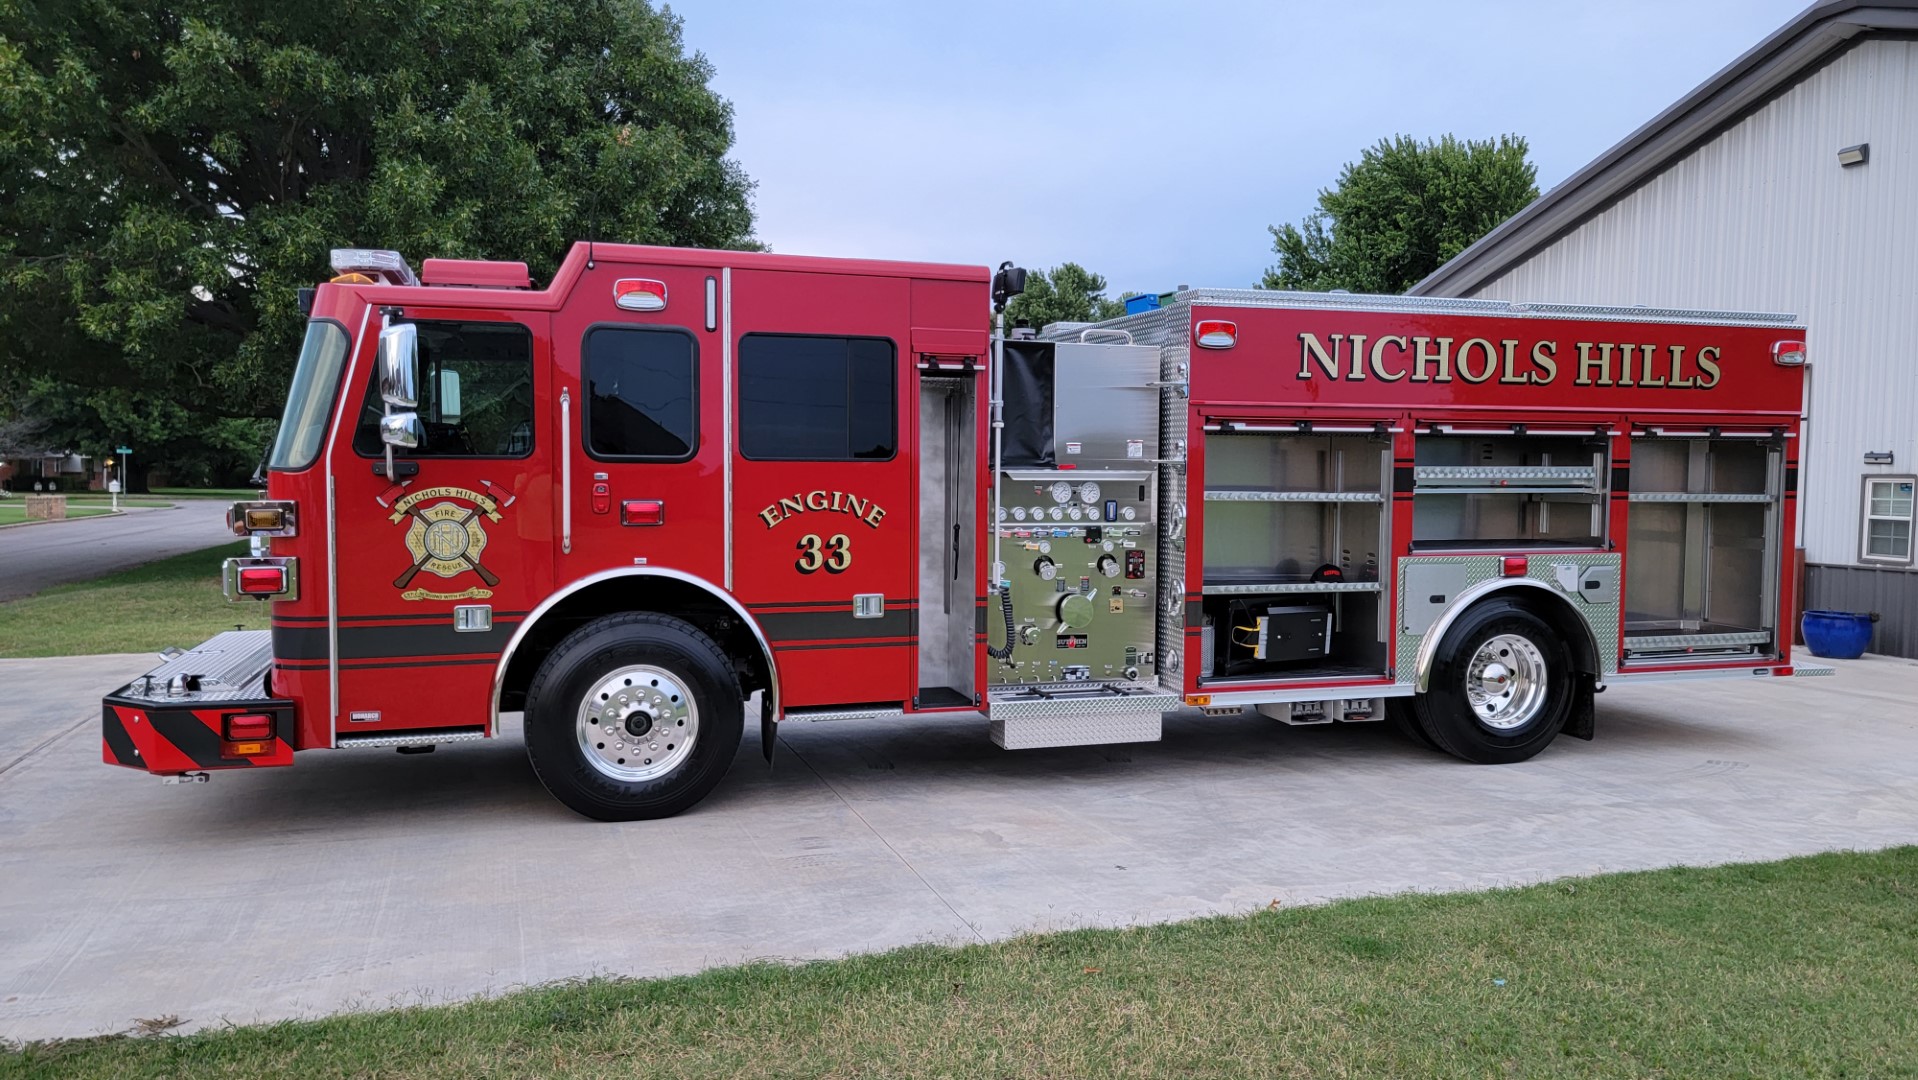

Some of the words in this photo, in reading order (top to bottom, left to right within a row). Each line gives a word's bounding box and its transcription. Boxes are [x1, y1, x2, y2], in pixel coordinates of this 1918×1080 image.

[1296, 332, 1558, 385] NICHOLS
[1574, 341, 1723, 391] HILLS
[403, 488, 452, 507] NICHOLS
[456, 489, 487, 506] HILLS
[757, 490, 887, 530] ENGINE
[434, 510, 456, 518] FIRE
[430, 562, 464, 571] RESCUE
[794, 533, 853, 575] 33
